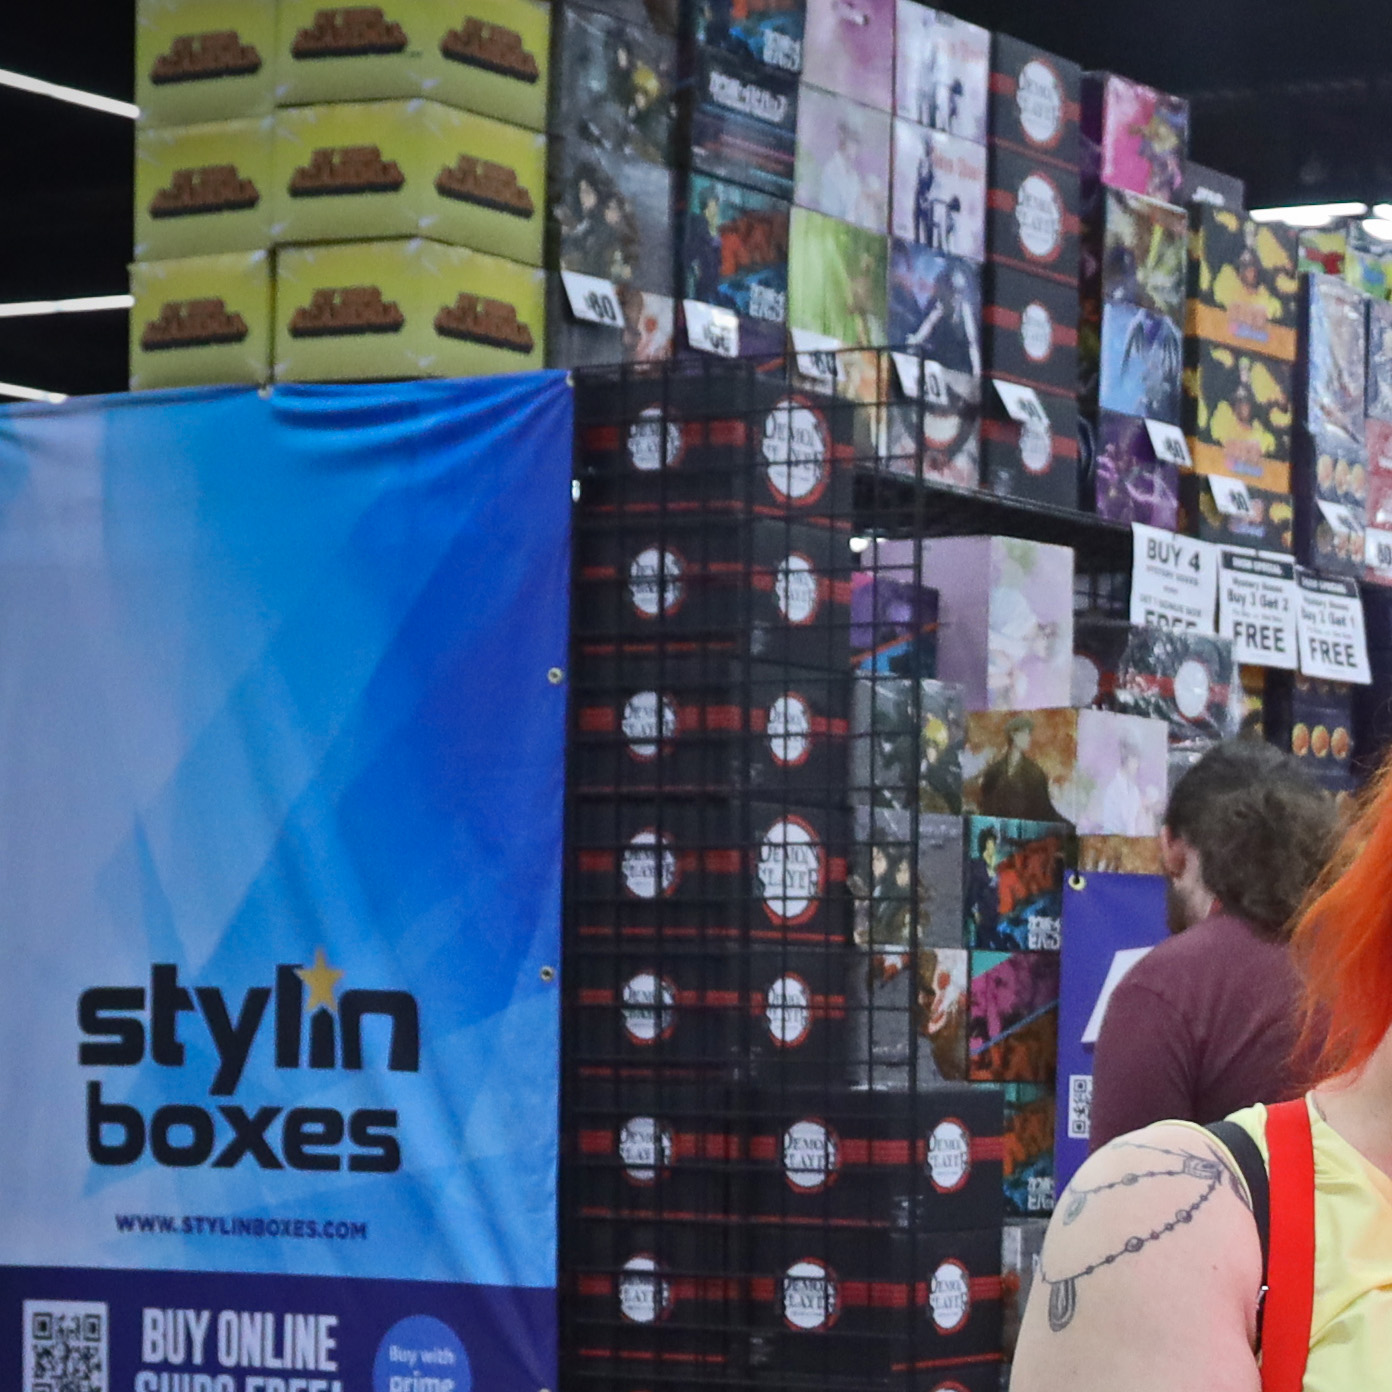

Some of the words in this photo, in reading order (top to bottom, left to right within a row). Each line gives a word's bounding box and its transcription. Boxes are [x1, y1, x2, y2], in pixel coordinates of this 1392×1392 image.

[1147, 538, 1182, 567] BUY
[1188, 551, 1200, 572] 4
[1227, 588, 1246, 607] Buy
[1260, 594, 1278, 610] Get
[1145, 609, 1198, 631] FR
[1233, 620, 1285, 653] FREE
[1308, 637, 1357, 668] FREE
[77, 955, 419, 1097] stylin
[87, 1082, 402, 1173] boxes
[115, 1214, 368, 1241] WWW.STYLINBOXES.COM
[141, 1307, 211, 1366] BUY
[216, 1309, 340, 1373] ONLINE
[390, 1345, 417, 1366] Buy
[419, 1346, 456, 1365] with
